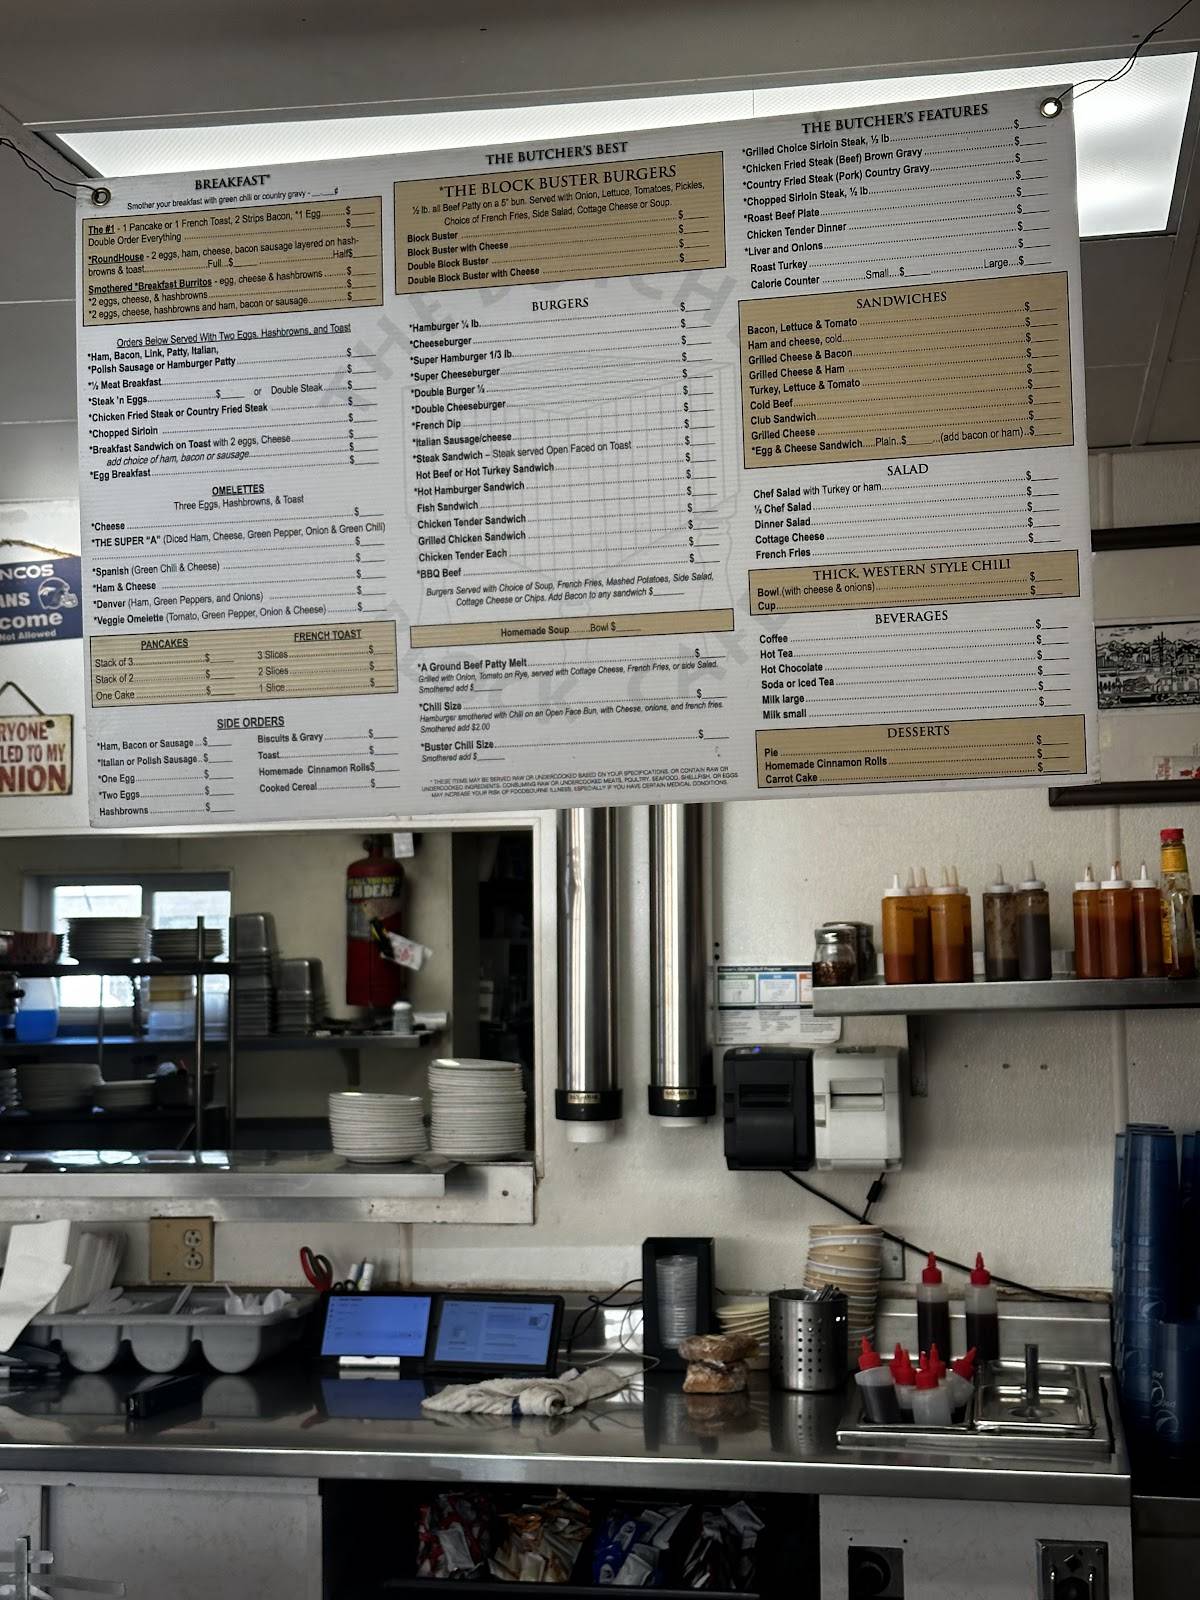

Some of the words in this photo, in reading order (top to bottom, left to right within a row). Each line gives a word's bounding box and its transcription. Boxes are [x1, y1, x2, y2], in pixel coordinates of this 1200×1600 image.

[801, 120, 830, 134] THE
[835, 111, 913, 130] BUTCHER'S
[918, 104, 988, 122] FEATURES
[485, 153, 513, 165] THE
[518, 146, 592, 162] BUTCHER'S
[596, 142, 628, 154] BEST
[482, 178, 535, 193] BLOCK
[539, 172, 599, 188] BUSTER
[603, 166, 676, 182] BURGERS
[127, 200, 154, 211] Smother
[156, 201, 170, 211] your
[172, 197, 202, 207] breakfast
[204, 196, 217, 205] with
[218, 196, 237, 206] green
[239, 193, 251, 203] chili
[253, 194, 260, 202] or
[261, 191, 286, 203] country
[287, 191, 306, 201] gravy
[444, 214, 469, 226] Choice
[472, 214, 479, 224] of
[481, 211, 506, 223] French
[532, 208, 548, 219] Side
[576, 203, 606, 217] Cottage
[608, 201, 637, 212] Cheese
[639, 202, 647, 210] or
[407, 232, 429, 243] Block
[431, 230, 457, 241] Buster
[747, 227, 782, 240] Chicken
[784, 224, 814, 237] Tender
[817, 222, 846, 234] Dinner
[88, 236, 114, 246] Double
[117, 235, 138, 245] Order
[141, 233, 181, 246] Everything
[407, 246, 429, 257] Block
[432, 244, 458, 256] Buster
[460, 243, 476, 254] with
[478, 241, 508, 252] Cheese
[407, 259, 435, 270] Double
[437, 258, 459, 269] Block
[462, 256, 488, 267] Buster
[750, 261, 775, 273] Roast
[408, 274, 435, 285] Double
[438, 272, 460, 283] Block
[462, 270, 488, 281] Buster
[490, 269, 507, 279] with
[509, 266, 539, 278] Cheese
[751, 277, 781, 290] Calorie
[784, 274, 819, 287] Counter
[532, 298, 588, 312] BURGERS
[856, 291, 946, 309] SANDWICHES
[780, 321, 812, 333] Lettuce
[815, 320, 822, 330] &
[824, 317, 857, 330] Tomato
[116, 338, 142, 347] Orders
[145, 336, 168, 345] Below
[170, 334, 197, 344] Served
[200, 333, 217, 342] With
[219, 332, 234, 341] Two
[314, 325, 328, 334] and
[330, 323, 351, 333] Toast
[749, 368, 777, 380] Grilled
[780, 366, 812, 378] Cheese
[815, 365, 822, 375] &
[824, 364, 844, 375] Ham
[783, 381, 815, 393] Lettuce
[818, 380, 824, 391] &
[827, 378, 860, 390] Tomato
[751, 429, 780, 440] Grilled
[782, 427, 815, 438] Cheese
[887, 464, 928, 476] SALAD
[212, 484, 264, 495] OMELETTES
[753, 488, 773, 499] Chef
[776, 486, 800, 497] Salad
[803, 485, 819, 496] with
[822, 484, 850, 497] Turkey
[852, 485, 860, 493] or
[173, 500, 196, 511] Three
[275, 496, 280, 505] &
[283, 494, 303, 505] Toast
[417, 502, 434, 513] Fish
[437, 500, 478, 512] Sandwich
[417, 518, 451, 529] Chicken
[453, 516, 482, 527] Tender
[485, 514, 525, 526] Sandwich
[418, 534, 445, 545] Grilled
[448, 533, 482, 544] Chicken
[484, 530, 525, 542] Sandwich
[755, 533, 789, 546] Cottage
[792, 531, 824, 542] Cheese
[418, 551, 452, 562] Chicken
[455, 549, 484, 560] Tender
[756, 548, 786, 559] French
[789, 547, 810, 558] Fries
[862, 564, 925, 577] WESTERN
[930, 562, 968, 574] STYLE
[971, 560, 1010, 571] CHILI
[875, 611, 948, 624] BEVERAGES
[18, 629, 57, 640] Allowed
[294, 631, 330, 642] FRENCH
[333, 629, 361, 640] TOAST
[500, 626, 545, 637] Homemade
[140, 638, 188, 649] PANCAKES
[759, 633, 787, 644] Coffee
[760, 664, 776, 674] Hot
[778, 662, 822, 673] Chocolate
[761, 679, 783, 689] Soda
[786, 680, 795, 688] or
[818, 677, 834, 687] Tea
[95, 690, 112, 700] One
[763, 709, 780, 719] Milk
[783, 709, 806, 719] small
[217, 718, 240, 729] SIDE
[243, 717, 284, 728] ORDERS
[888, 726, 949, 737] DESSERTS
[27, 744, 43, 763] TO
[47, 743, 66, 762] MY
[764, 748, 778, 757] Pie
[765, 759, 814, 771] Homemade
[816, 757, 861, 768] Cinnamon
[765, 774, 793, 784] Carrot
[795, 773, 817, 783] Cake
[259, 783, 289, 793] Cooked
[292, 782, 317, 792] Cereal
[99, 805, 148, 815] Hashbrowns
